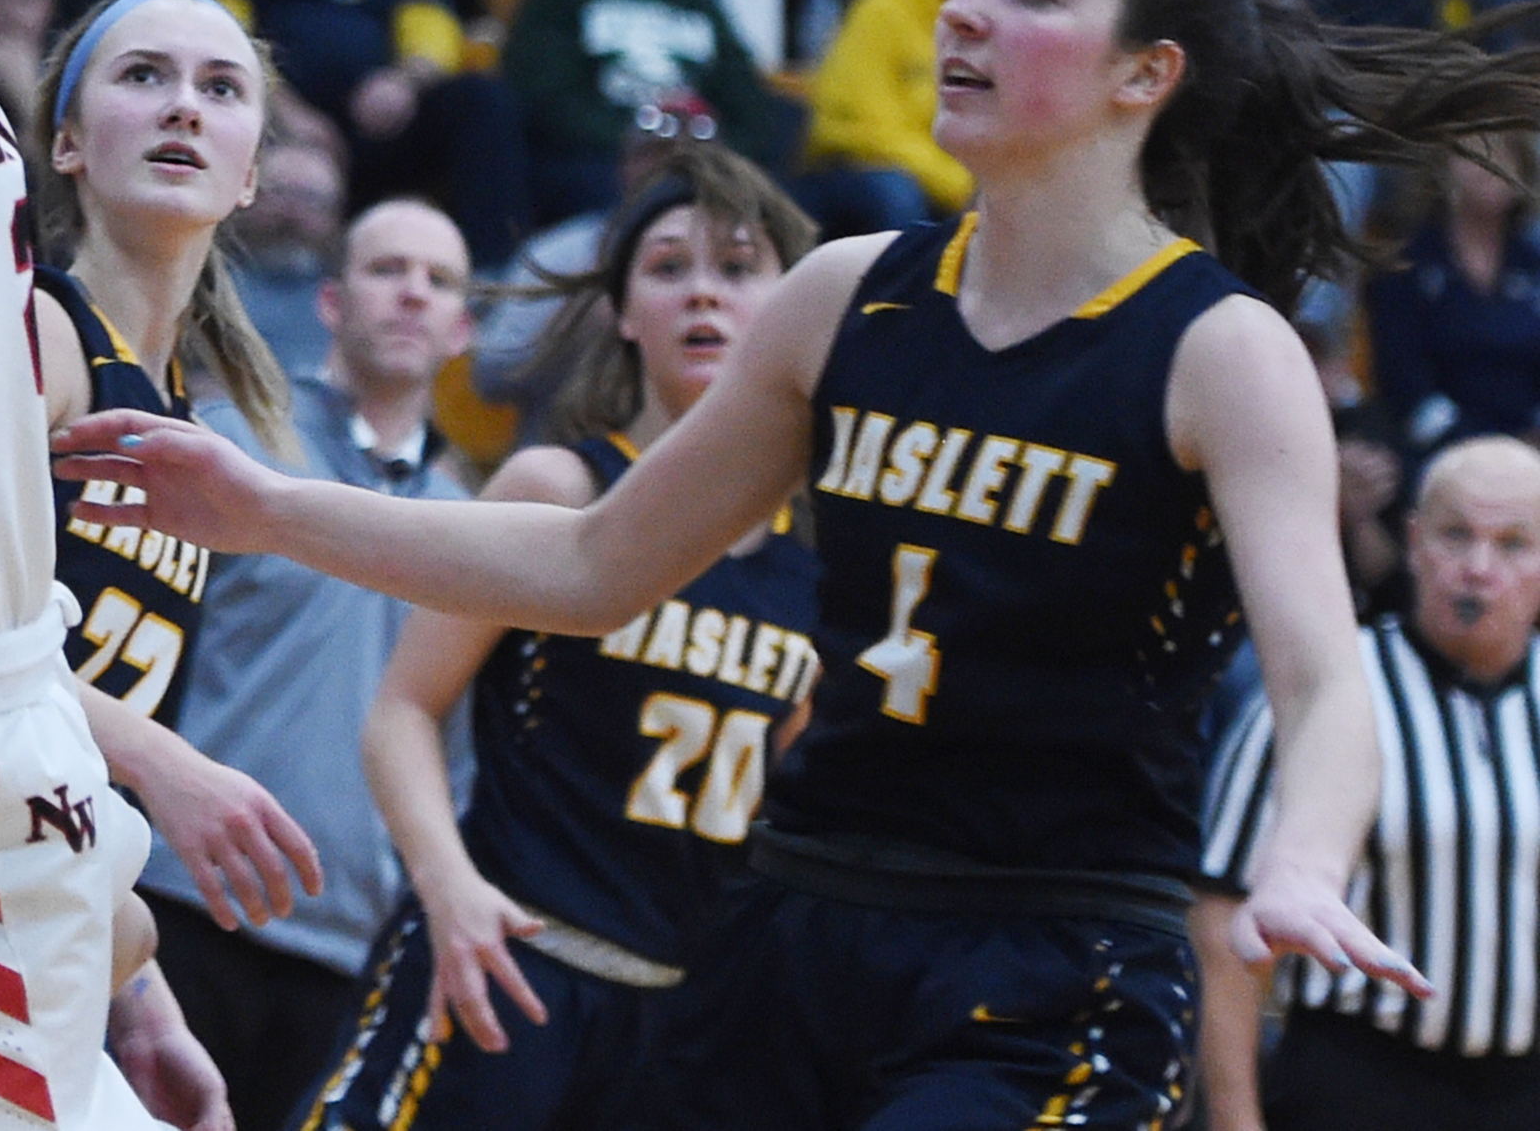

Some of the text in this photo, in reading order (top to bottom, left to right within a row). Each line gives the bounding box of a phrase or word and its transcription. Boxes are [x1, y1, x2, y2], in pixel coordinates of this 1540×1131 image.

[856, 542, 942, 726] 4
[24, 783, 96, 854] NW
[624, 692, 772, 846] 20
